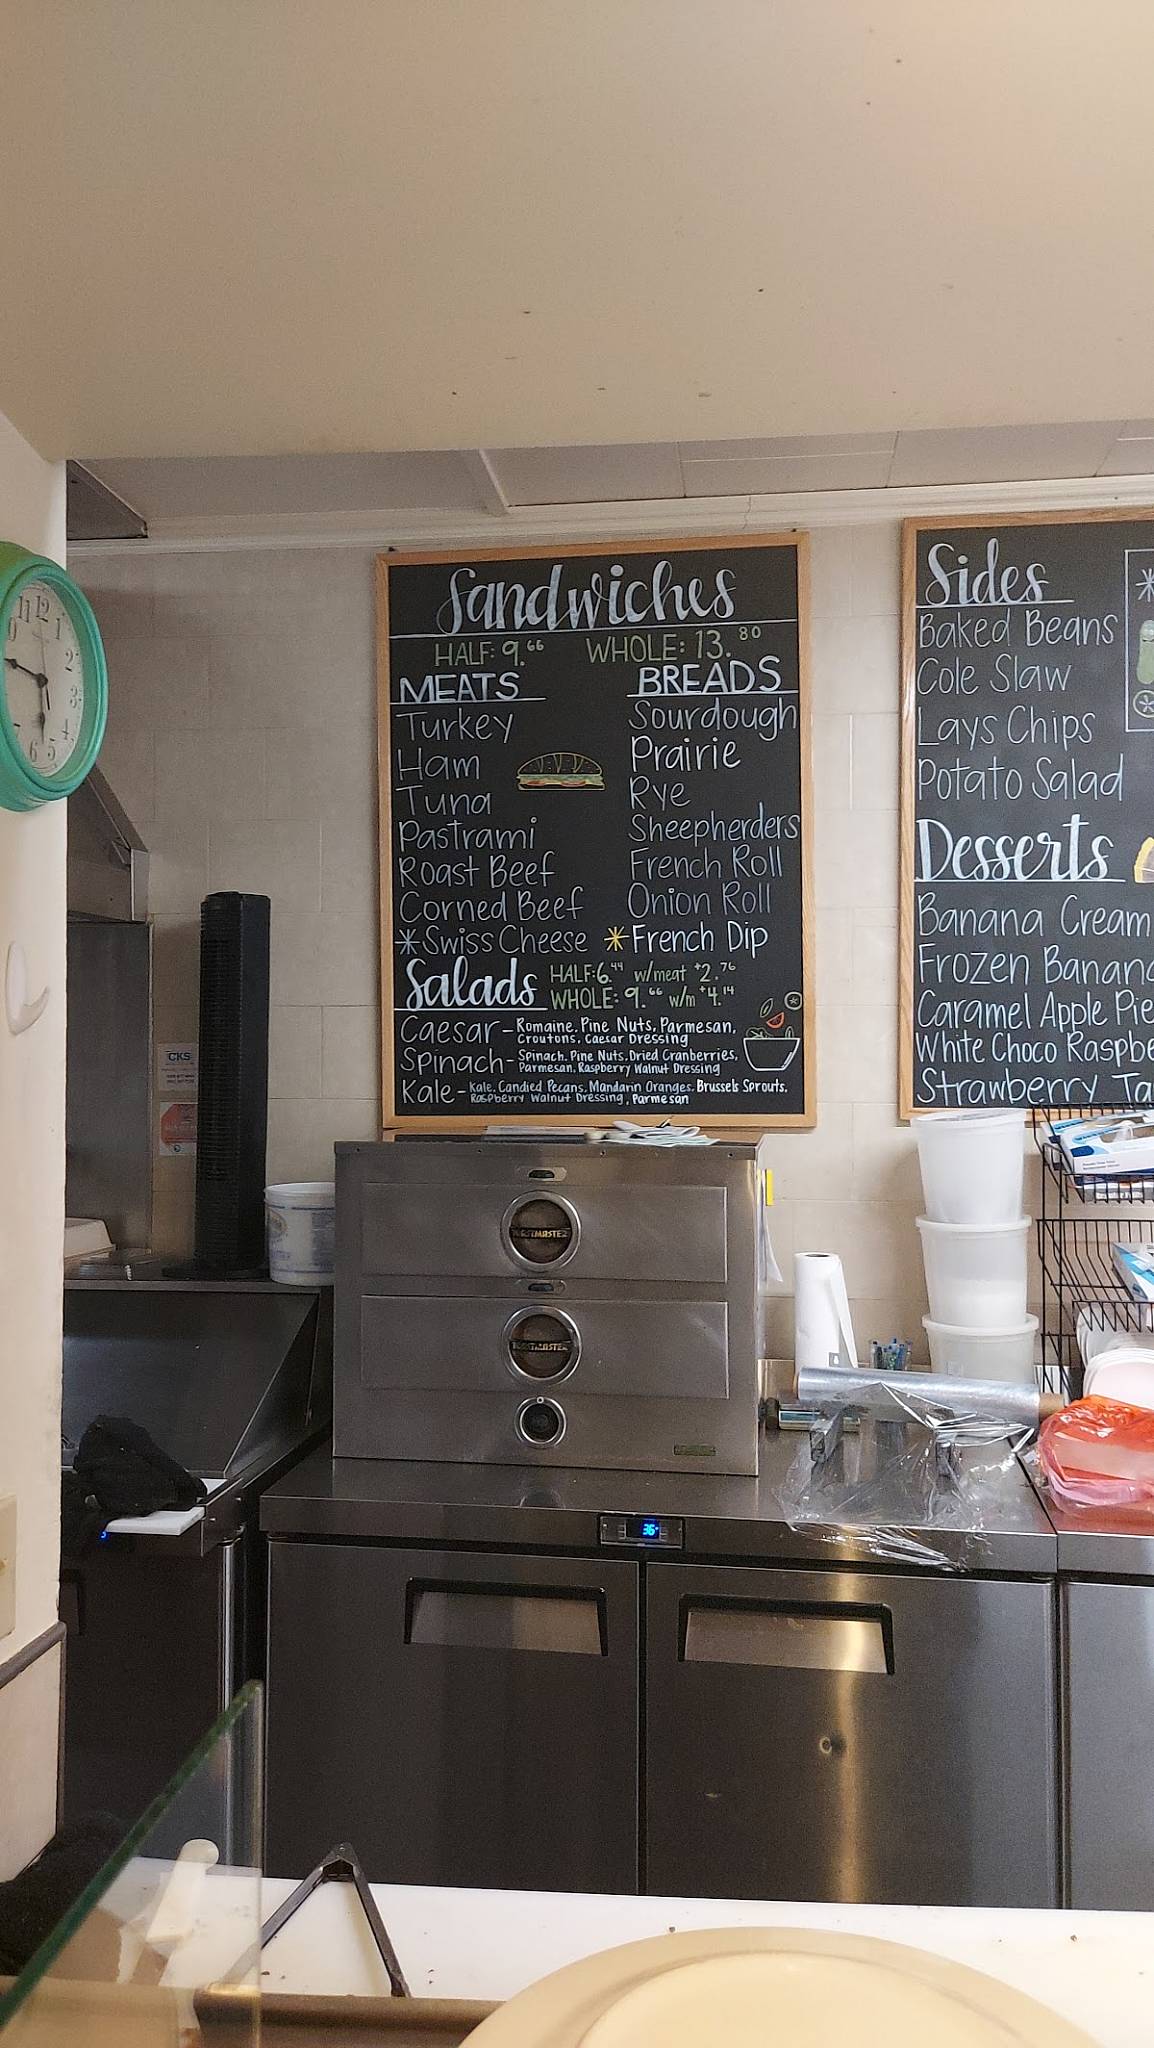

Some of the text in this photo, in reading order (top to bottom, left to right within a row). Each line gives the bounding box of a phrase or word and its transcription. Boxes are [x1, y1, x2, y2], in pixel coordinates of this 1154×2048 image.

[925, 537, 1049, 606] Sides
[18, 595, 30, 623] 11
[36, 595, 50, 623] 12
[437, 560, 736, 635] Sandwiches
[56, 618, 61, 640] 1
[919, 608, 1118, 649] Baked Beans
[64, 648, 74, 672] 2
[435, 642, 495, 667] HALF:
[585, 634, 686, 663] WHOLE:
[400, 671, 520, 703] MEATS
[639, 656, 782, 695] BREADS
[917, 653, 1072, 695] Cole Slaw
[70, 684, 78, 709] 3
[61, 719, 69, 740] 4
[395, 707, 515, 744] Turkey
[628, 697, 797, 742] Sourdough
[918, 705, 1096, 751] Lays Chips
[29, 740, 37, 762] 6
[47, 738, 56, 761] 5
[397, 748, 480, 782] Ham
[631, 735, 741, 773] Prairie
[629, 776, 690, 812] Rye
[918, 753, 1124, 801] Potato Salad
[395, 784, 491, 816] Tuna
[399, 817, 536, 852] Pastrami
[628, 802, 800, 847] Sheepherders
[630, 844, 782, 881] French Roll
[915, 814, 1114, 881] Desserts
[399, 851, 555, 889] Roast Beef
[399, 886, 584, 923] Corned Beef
[627, 881, 771, 918] Onion Roll
[917, 892, 1150, 937] Banana Cream
[422, 927, 588, 955] Swiss Cheese
[633, 921, 768, 958] French Dip
[634, 960, 687, 983] w/meat
[918, 943, 1030, 985] Frozen
[406, 955, 538, 1011] Salads
[550, 987, 619, 1009] WHOLE:
[669, 985, 695, 1008] w/m
[580, 1016, 610, 1033] Pine
[616, 1015, 657, 1033] Nuts,
[660, 1016, 736, 1034] Parmesan,
[917, 989, 1154, 1033] Caramel Apple Pie
[168, 1052, 192, 1061] CKS
[517, 1033, 688, 1047] Croutons, Caesar Dressing
[570, 1049, 594, 1061] Pine
[629, 1048, 659, 1061] Dried
[662, 1048, 738, 1061] Cranberries,
[915, 1032, 985, 1063] White
[992, 1032, 1057, 1064] Choco
[498, 1080, 542, 1092] Candied
[589, 1079, 641, 1093] Mandarin
[697, 1079, 739, 1093] Brussels
[578, 1062, 631, 1077] Raspberry
[634, 1063, 669, 1074] Walnut
[673, 1063, 720, 1076] Dressing
[470, 1093, 524, 1103] Raspberry
[530, 1093, 571, 1103] Walnut
[632, 1093, 689, 1104] Parmesan
[916, 1068, 1097, 1106] Strawberry
[512, 1229, 568, 1238] ASTMASTER
